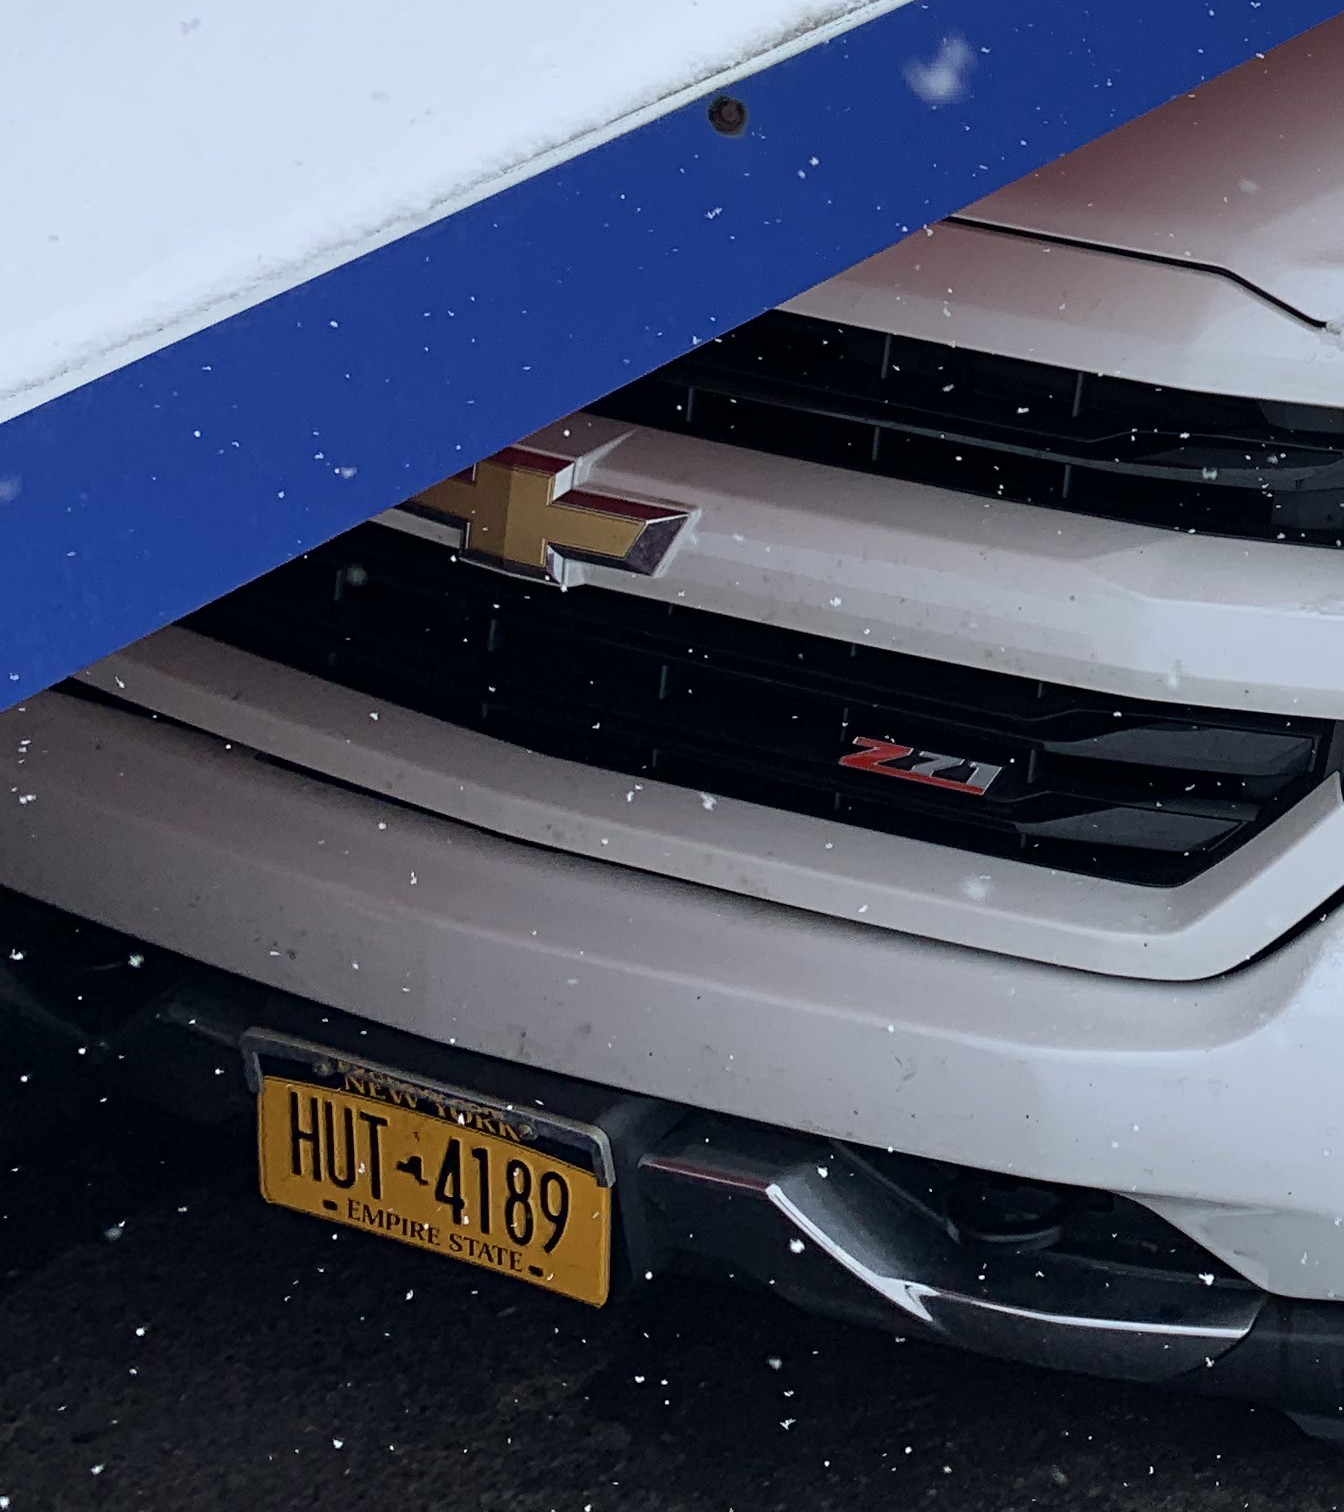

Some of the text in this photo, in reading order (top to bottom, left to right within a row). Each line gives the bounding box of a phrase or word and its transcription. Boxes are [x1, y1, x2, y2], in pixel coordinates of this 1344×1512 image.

[838, 736, 1003, 796] Z71
[290, 1090, 571, 1254] HUT 4189
[346, 1198, 523, 1273] EMPIRE STATE
